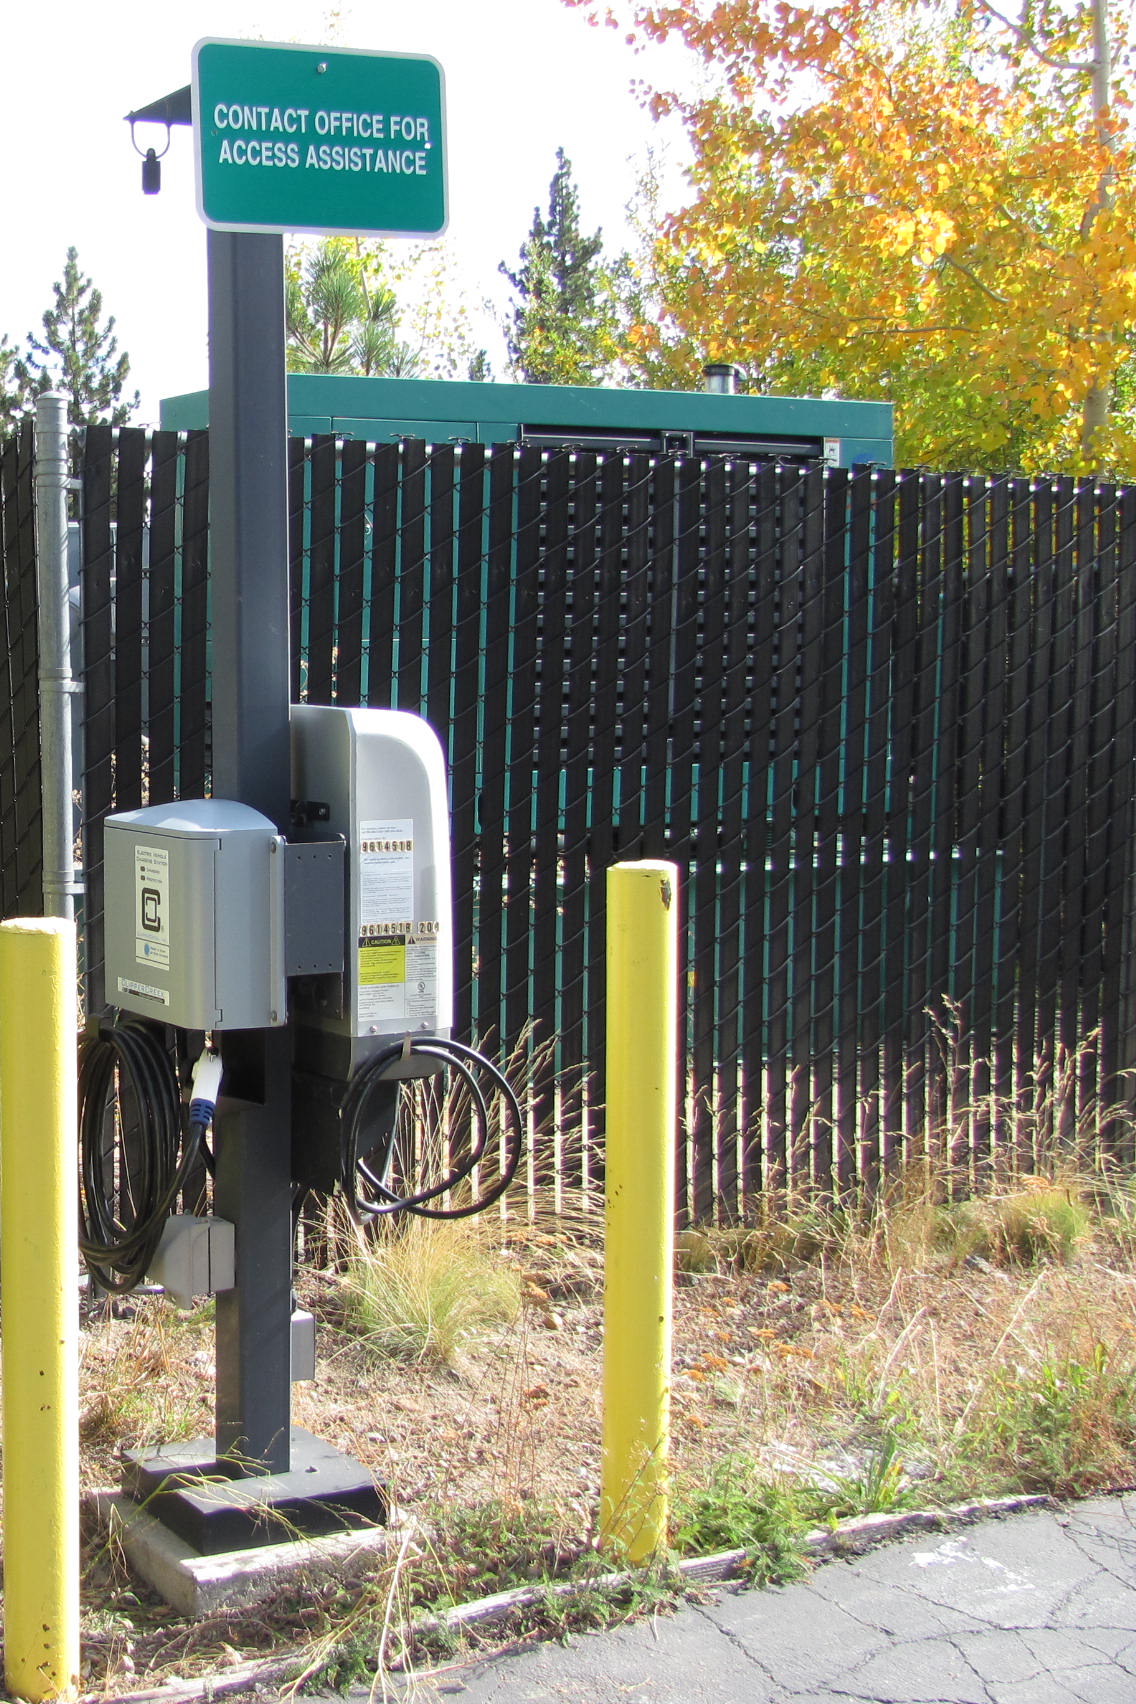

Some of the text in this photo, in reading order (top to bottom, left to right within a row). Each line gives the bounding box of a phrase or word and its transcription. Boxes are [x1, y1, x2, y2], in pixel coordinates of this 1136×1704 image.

[214, 104, 429, 142] CONTACT OFFICE FOR
[219, 139, 427, 176] ACCESS ASSISTANCE
[362, 840, 412, 852] 9614518
[361, 922, 412, 936] 9614518
